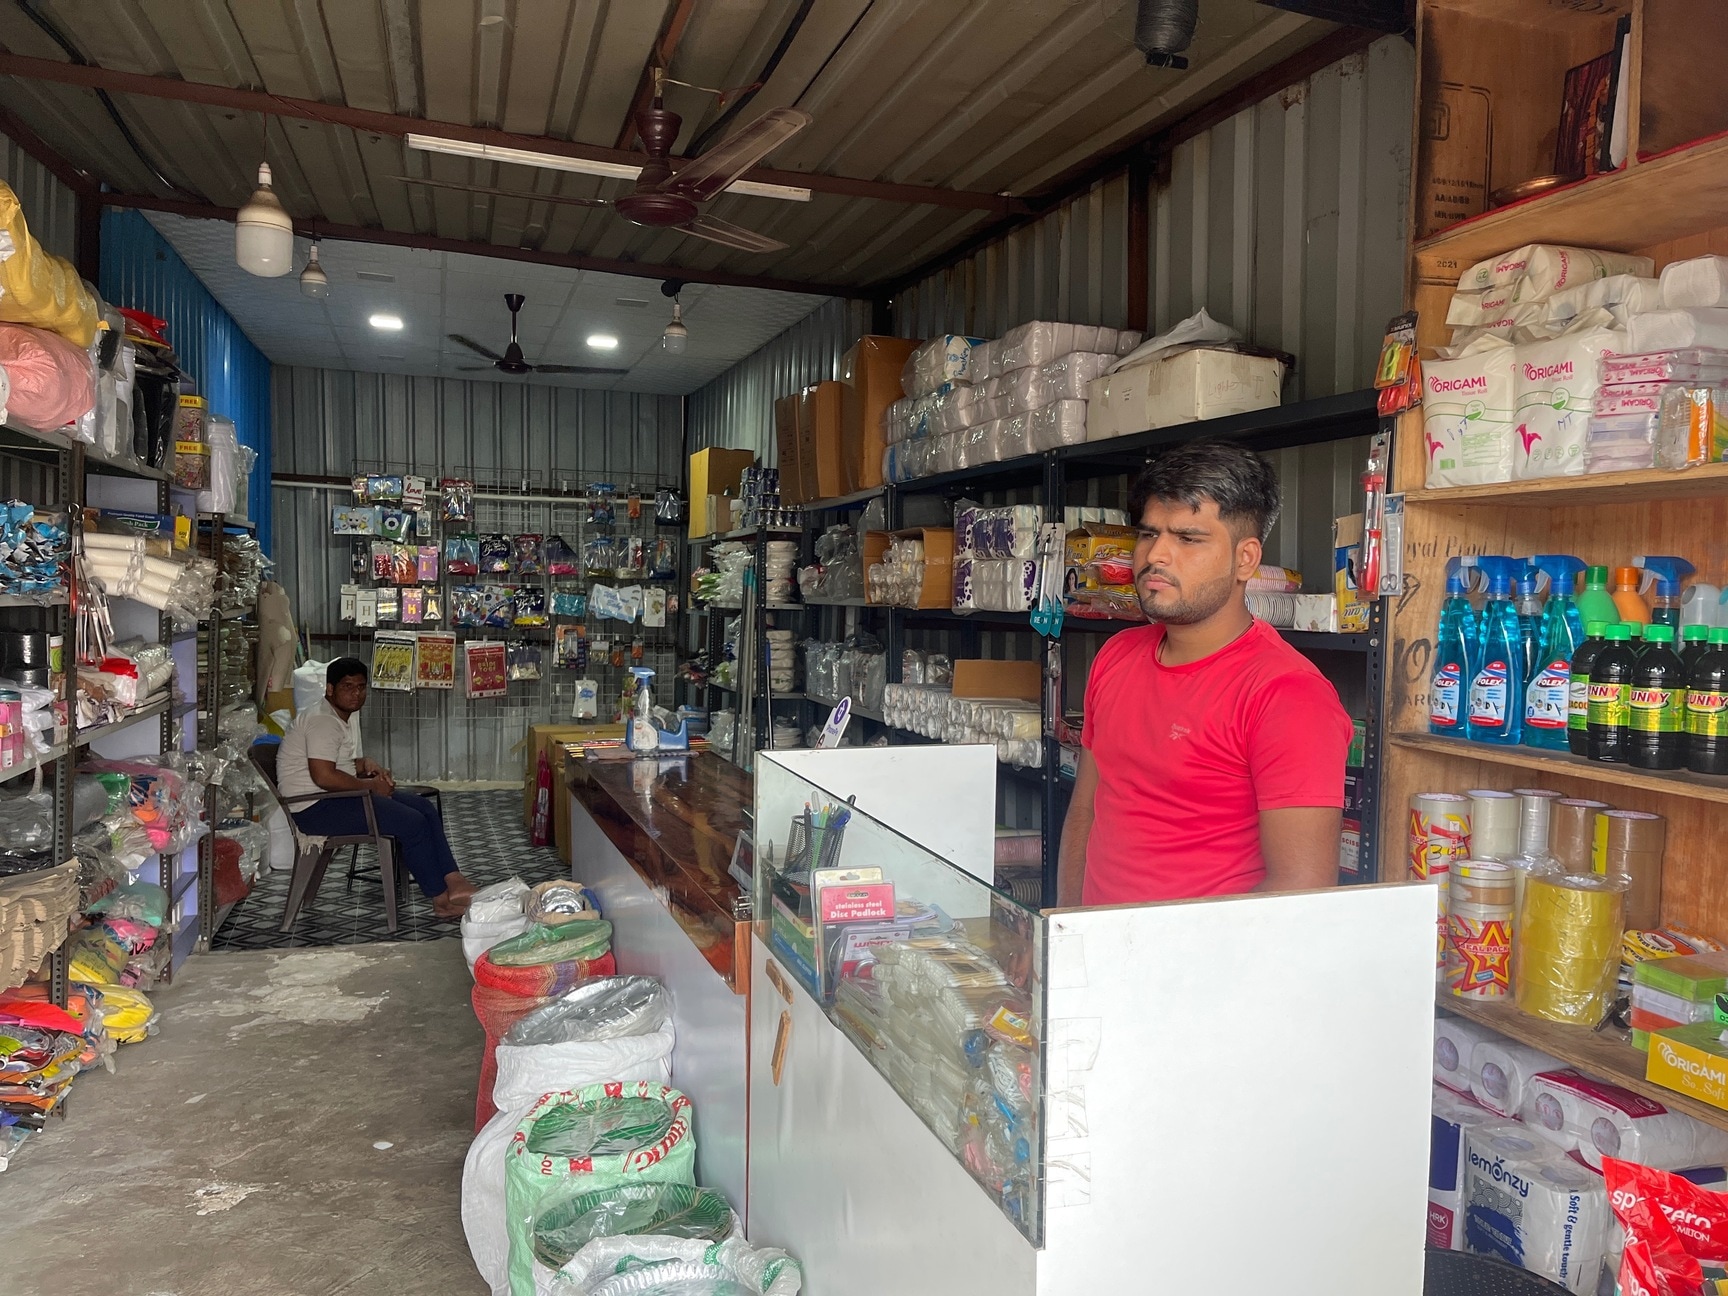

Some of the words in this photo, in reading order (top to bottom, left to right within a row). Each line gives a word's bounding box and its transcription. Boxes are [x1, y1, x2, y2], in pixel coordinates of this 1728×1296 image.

[1436, 260, 1458, 269] 2021
[1522, 361, 1574, 381] ORIGAMI
[1428, 376, 1487, 393] ORIGAMI
[405, 483, 423, 495] love
[346, 600, 354, 611] H
[362, 606, 371, 616] H
[407, 604, 417, 615] H
[1476, 678, 1505, 686] FOLEX
[1536, 678, 1567, 687] FOLEX
[1630, 691, 1671, 702] UNNY
[835, 901, 864, 910] stainless
[865, 900, 883, 908] steel
[830, 911, 848, 919] Disc
[851, 908, 887, 918] Padlock
[1658, 1042, 1726, 1086] ORIGAMI
[1569, 1194, 1581, 1214] Soft
[1563, 1224, 1574, 1252] gentle
[1676, 1226, 1710, 1243] MILTON
